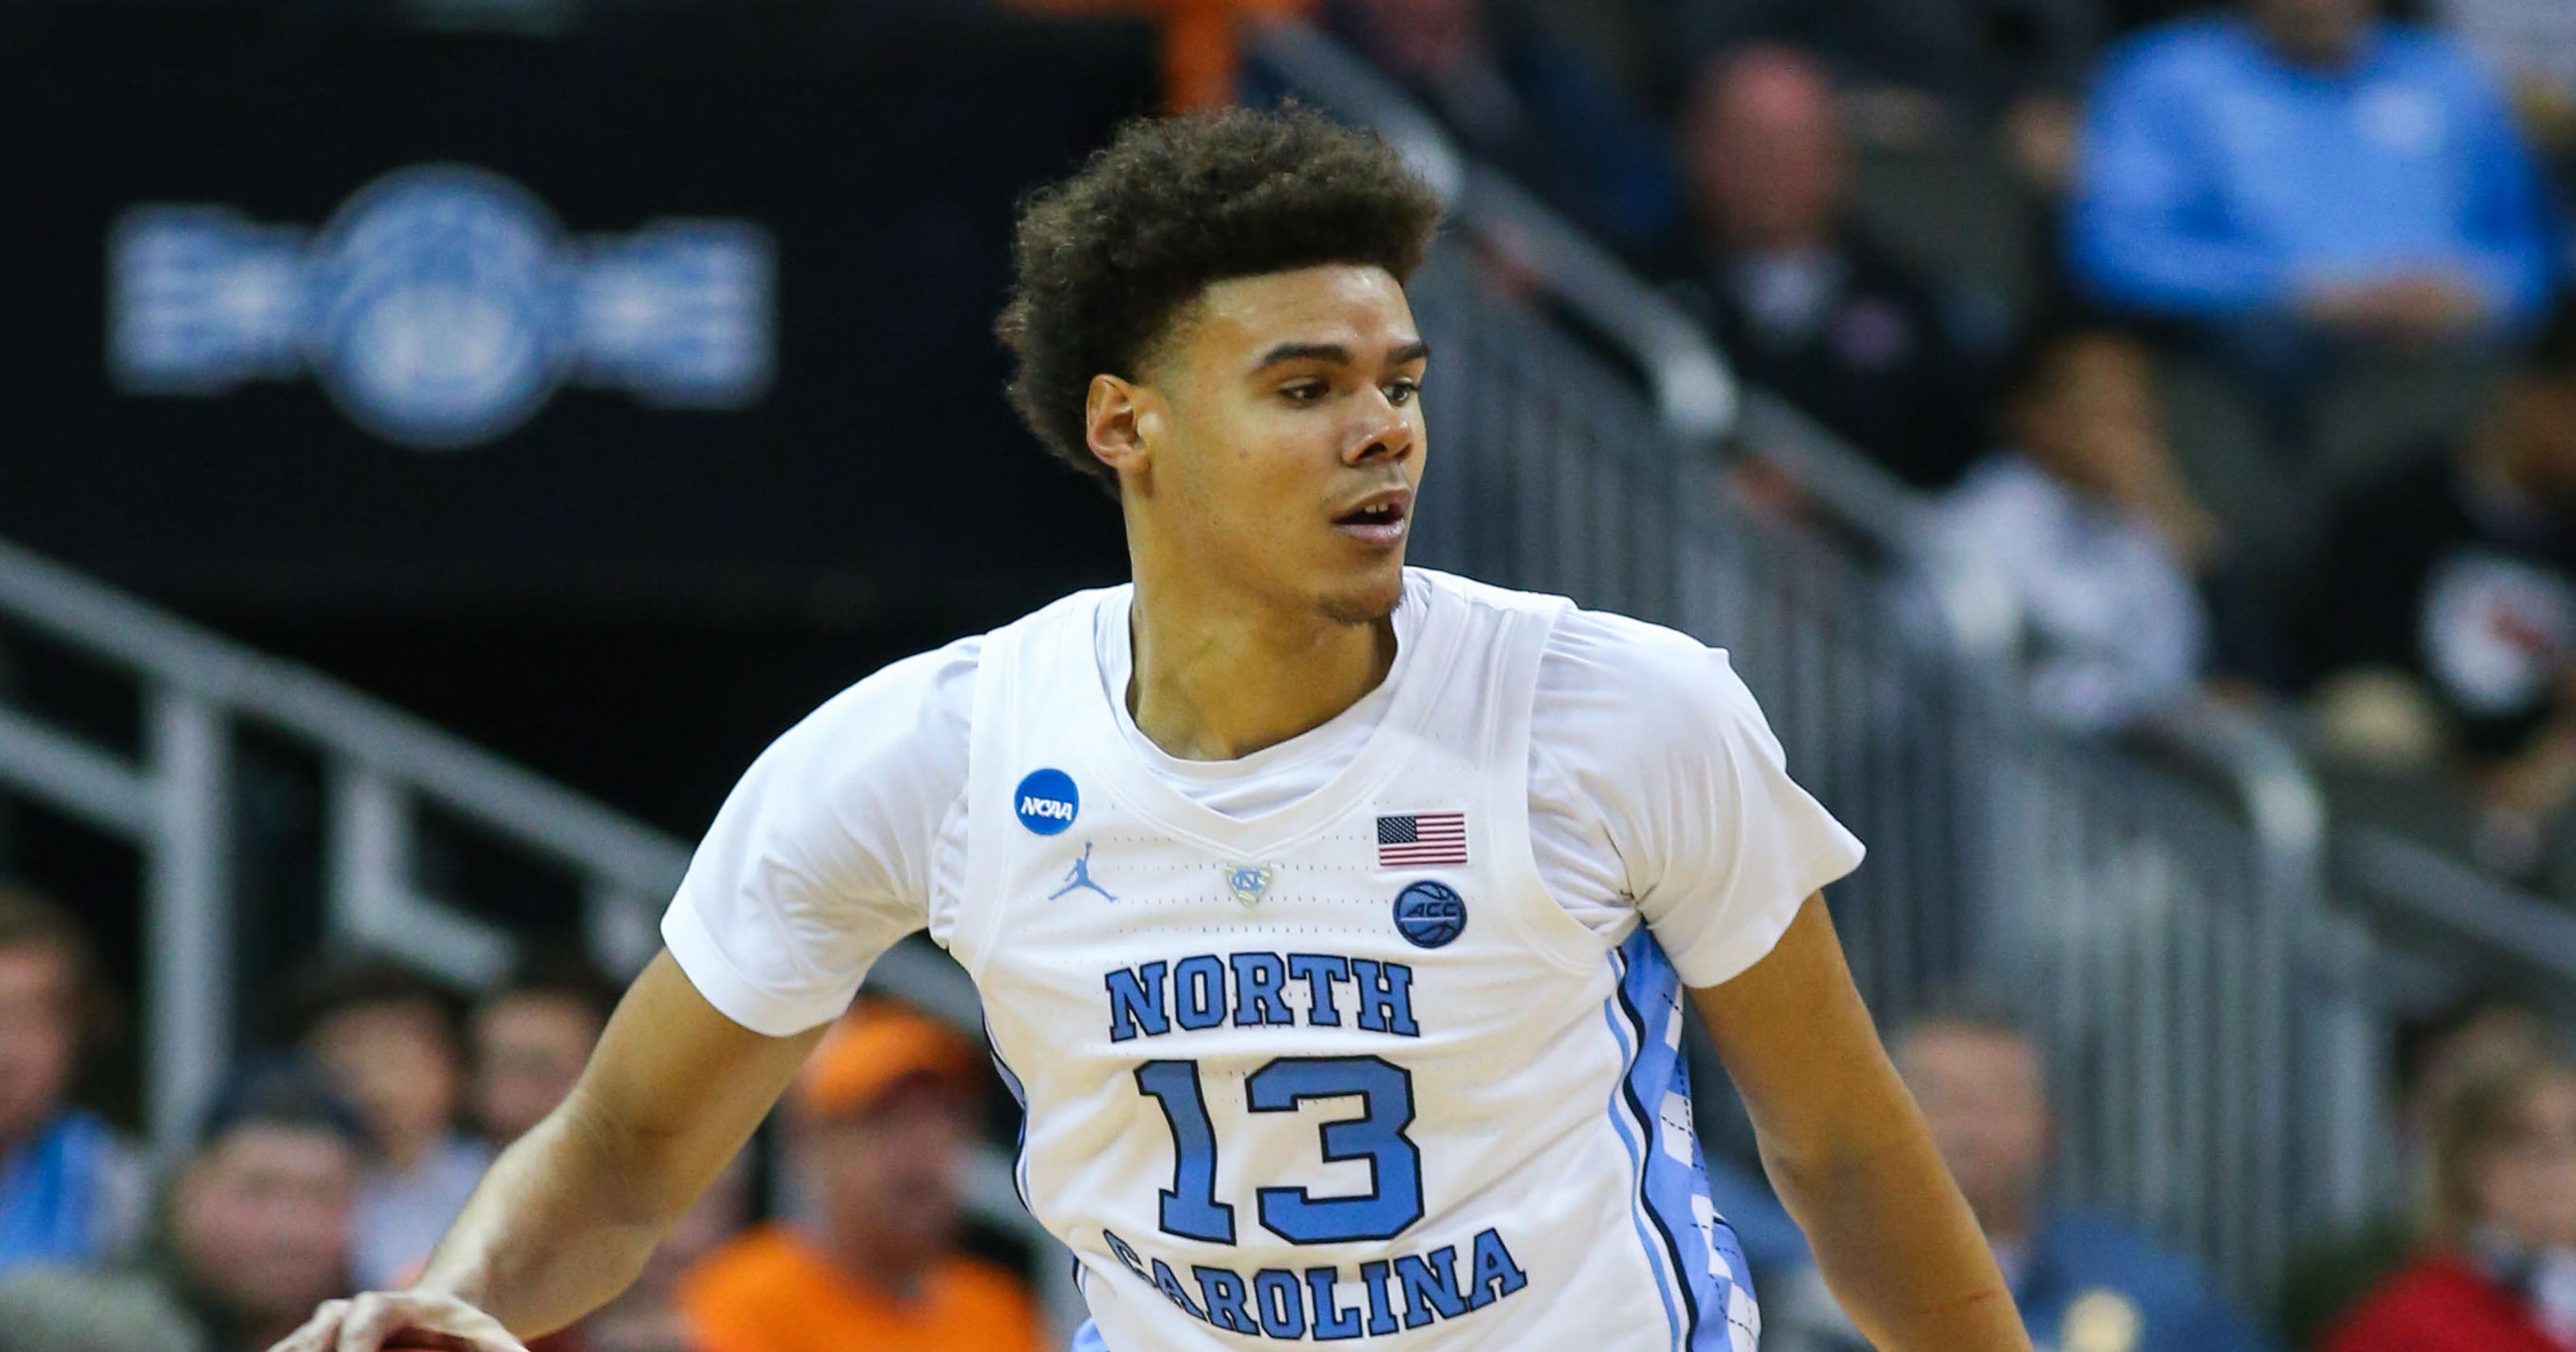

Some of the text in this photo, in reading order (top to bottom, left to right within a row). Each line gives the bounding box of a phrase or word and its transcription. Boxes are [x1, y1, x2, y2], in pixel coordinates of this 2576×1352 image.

[1020, 795, 1072, 821] NCAA
[1406, 902, 1458, 917] ACC
[1104, 951, 1421, 1044] NORTH
[1133, 1054, 1426, 1247] 13
[1102, 1227, 1528, 1341] CAROLINA
